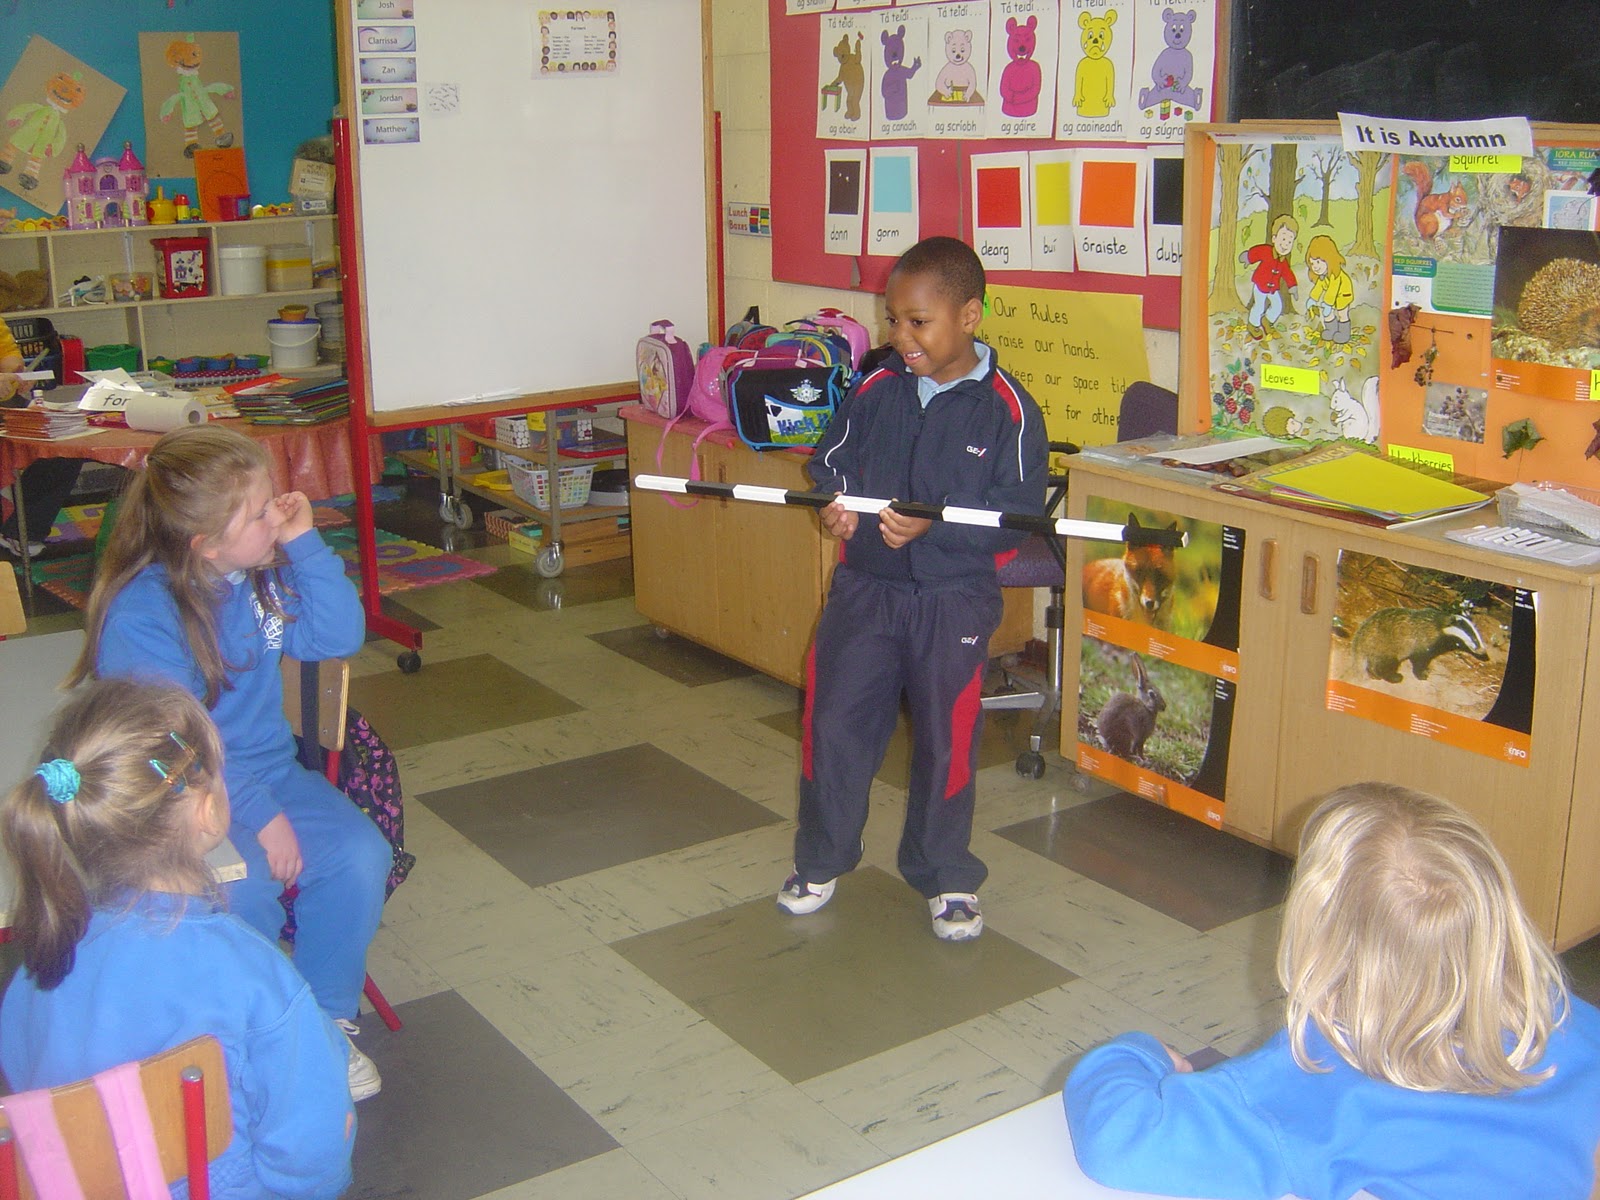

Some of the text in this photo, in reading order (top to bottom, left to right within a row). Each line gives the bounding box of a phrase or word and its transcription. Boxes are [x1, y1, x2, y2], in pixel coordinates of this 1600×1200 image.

[378, 0, 395, 9] Josh
[1001, 2, 1012, 13] Tá
[880, 13, 890, 23] Tá
[937, 7, 947, 18] Tá
[828, 18, 837, 28] Tá
[382, 66, 396, 74] Zan
[379, 94, 403, 102] Jordan
[376, 126, 408, 134] Matthew
[829, 124, 857, 136] ag obair
[881, 121, 917, 135] ag canadh
[935, 121, 977, 134] ag scríobh
[1001, 121, 1036, 136] ag gáire
[1063, 120, 1123, 135] ag caoineadh
[1140, 126, 1152, 139] ag
[1356, 124, 1507, 149] It is Autumn
[1555, 150, 1576, 158] IORA
[728, 202, 748, 217] Lunch
[728, 219, 748, 232] Boxes
[830, 224, 849, 241] donn
[876, 228, 900, 243] gorm
[981, 240, 1010, 264] dearg
[1043, 236, 1058, 255] buí
[1082, 236, 1128, 255] óraiste
[994, 296, 1069, 325] Our Rules
[998, 331, 1024, 349] raise
[1035, 338, 1055, 353] our
[1063, 336, 1100, 360] hands.
[1045, 374, 1062, 386] our
[1073, 376, 1100, 392] space
[1111, 376, 1128, 395] tid
[103, 393, 131, 407] for
[1066, 404, 1081, 420] for
